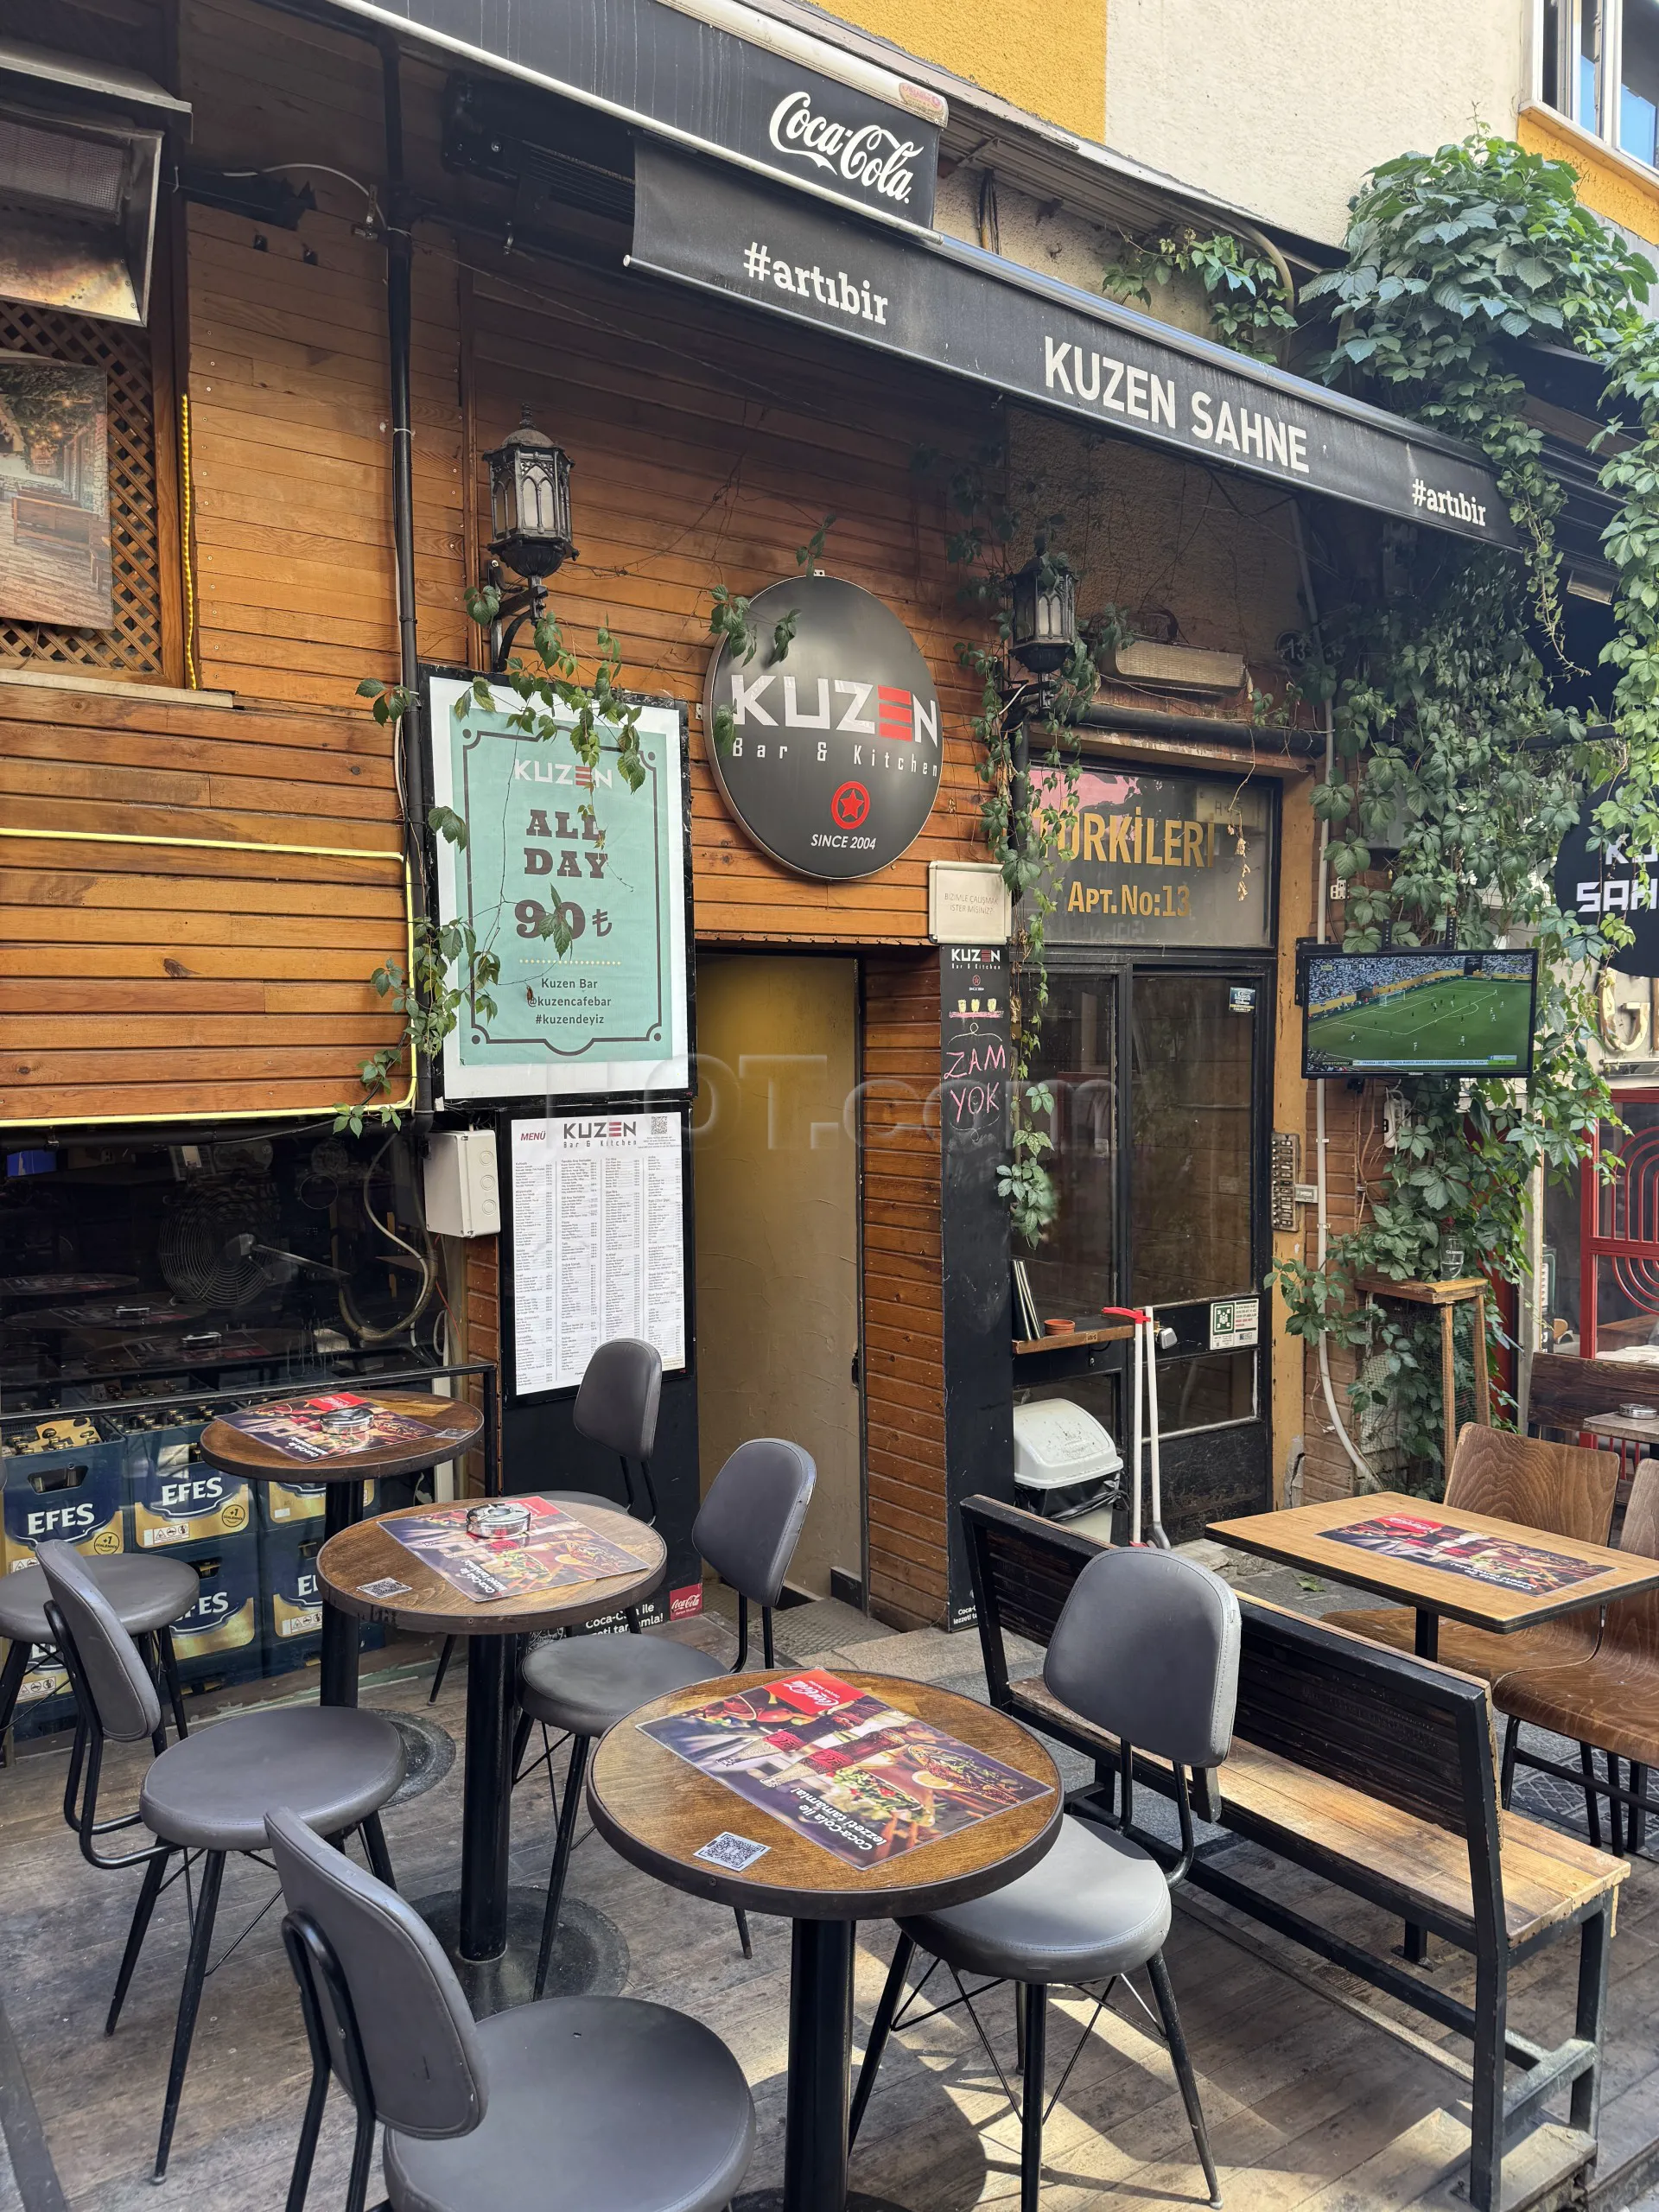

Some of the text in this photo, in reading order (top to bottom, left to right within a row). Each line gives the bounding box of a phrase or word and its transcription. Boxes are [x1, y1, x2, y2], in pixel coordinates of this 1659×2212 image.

[1045, 336, 1310, 474] KUZEN SAHNE
[731, 674, 938, 748] KUZEN
[732, 737, 938, 778] Bar & Kitchen
[514, 759, 613, 790] KUZEN
[526, 809, 606, 841] ALL
[810, 833, 877, 850] SINCE 2004
[524, 847, 608, 880] DAY
[951, 949, 1001, 963] KUZEN
[541, 978, 598, 988] Kuzen Bar
[527, 996, 612, 1007] @kuzencafebar
[535, 1014, 605, 1026] #kuzendeyiz
[944, 1044, 1007, 1080] ZAM
[950, 1082, 1000, 1124] YOK
[520, 1130, 546, 1141] MENÜ
[563, 1122, 637, 1140] KUZEN
[600, 1139, 637, 1147] Kitchen
[161, 1476, 224, 1506] EFES
[27, 1502, 95, 1536] EFES
[642, 1603, 655, 1615] ile
[814, 1813, 873, 1851] Coca-Cola
